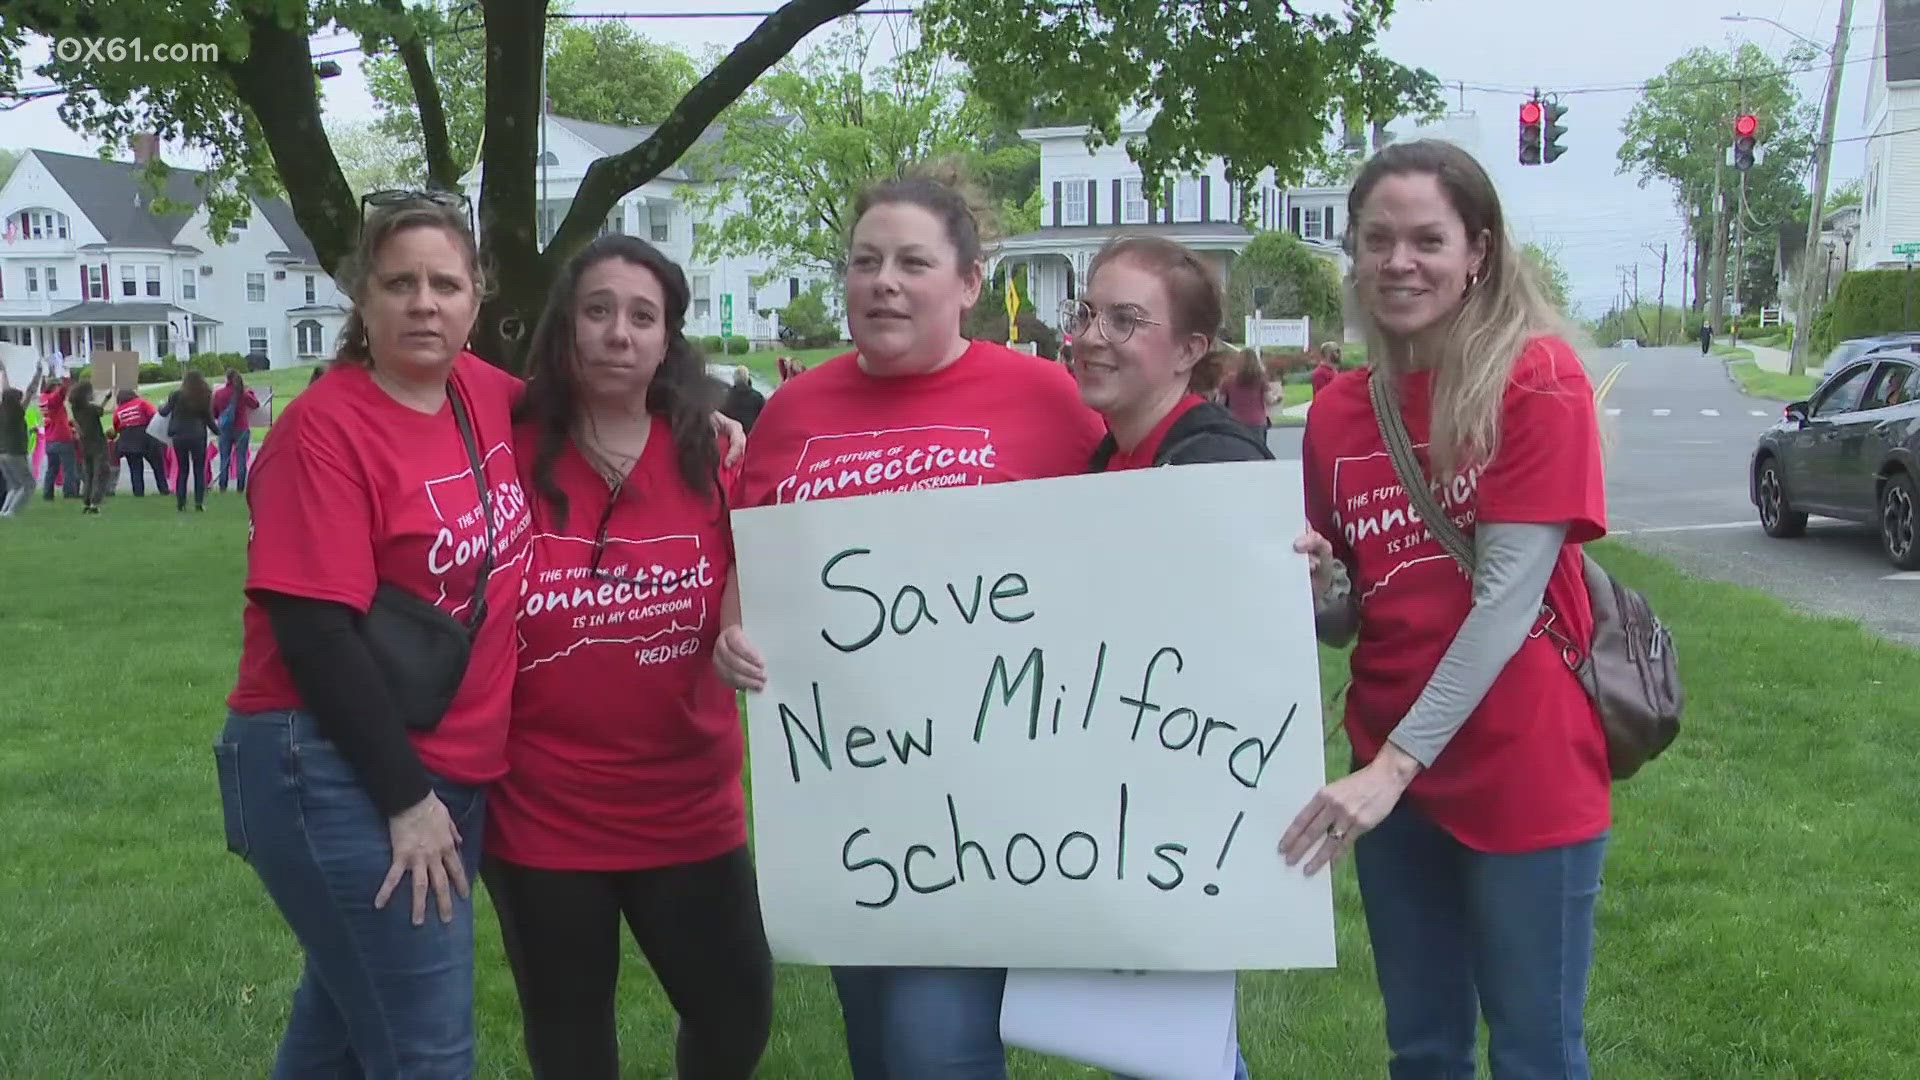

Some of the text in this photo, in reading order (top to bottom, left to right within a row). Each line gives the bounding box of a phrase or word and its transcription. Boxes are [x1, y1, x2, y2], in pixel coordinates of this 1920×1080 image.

[809, 445, 904, 473] THE FUTURE OF
[1347, 485, 1408, 512] THE FUTU
[457, 511, 475, 530] THE
[1386, 540, 1401, 554] IS
[1405, 534, 1420, 549] IN
[539, 568, 561, 583] THE
[573, 597, 692, 629] IS IN MY CLASSROOM
[821, 548, 1035, 652] Save
[777, 641, 1298, 788] New Milford
[842, 783, 1245, 908] Schools!
